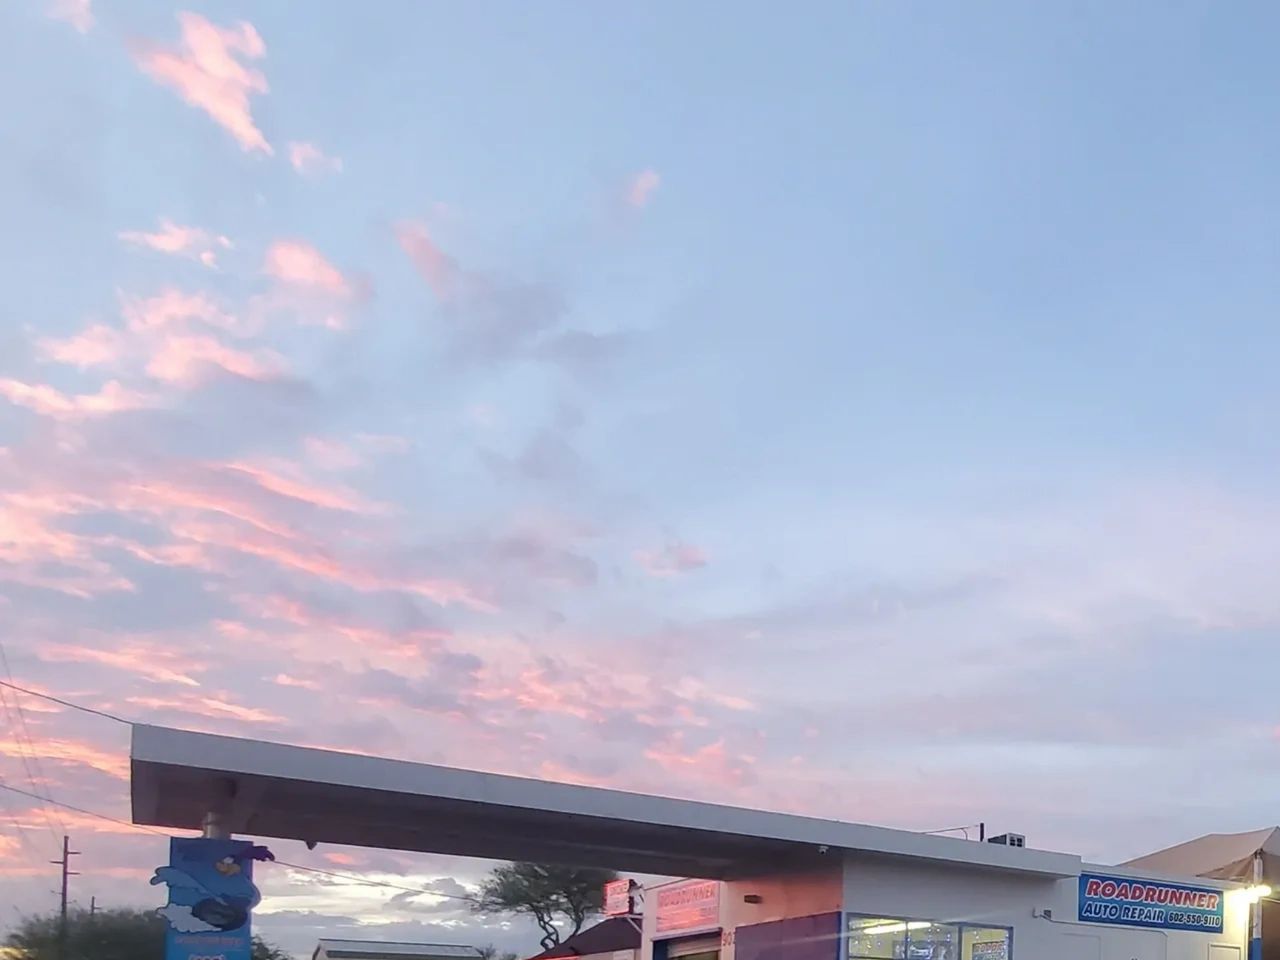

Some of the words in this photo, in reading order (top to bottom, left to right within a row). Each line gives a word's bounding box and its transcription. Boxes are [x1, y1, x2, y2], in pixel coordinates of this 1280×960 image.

[1086, 879, 1218, 910] ROADRUNNER
[1083, 901, 1119, 918] AUTO
[1121, 905, 1165, 923] REPAIR
[1168, 911, 1221, 928] 602-550-9110
